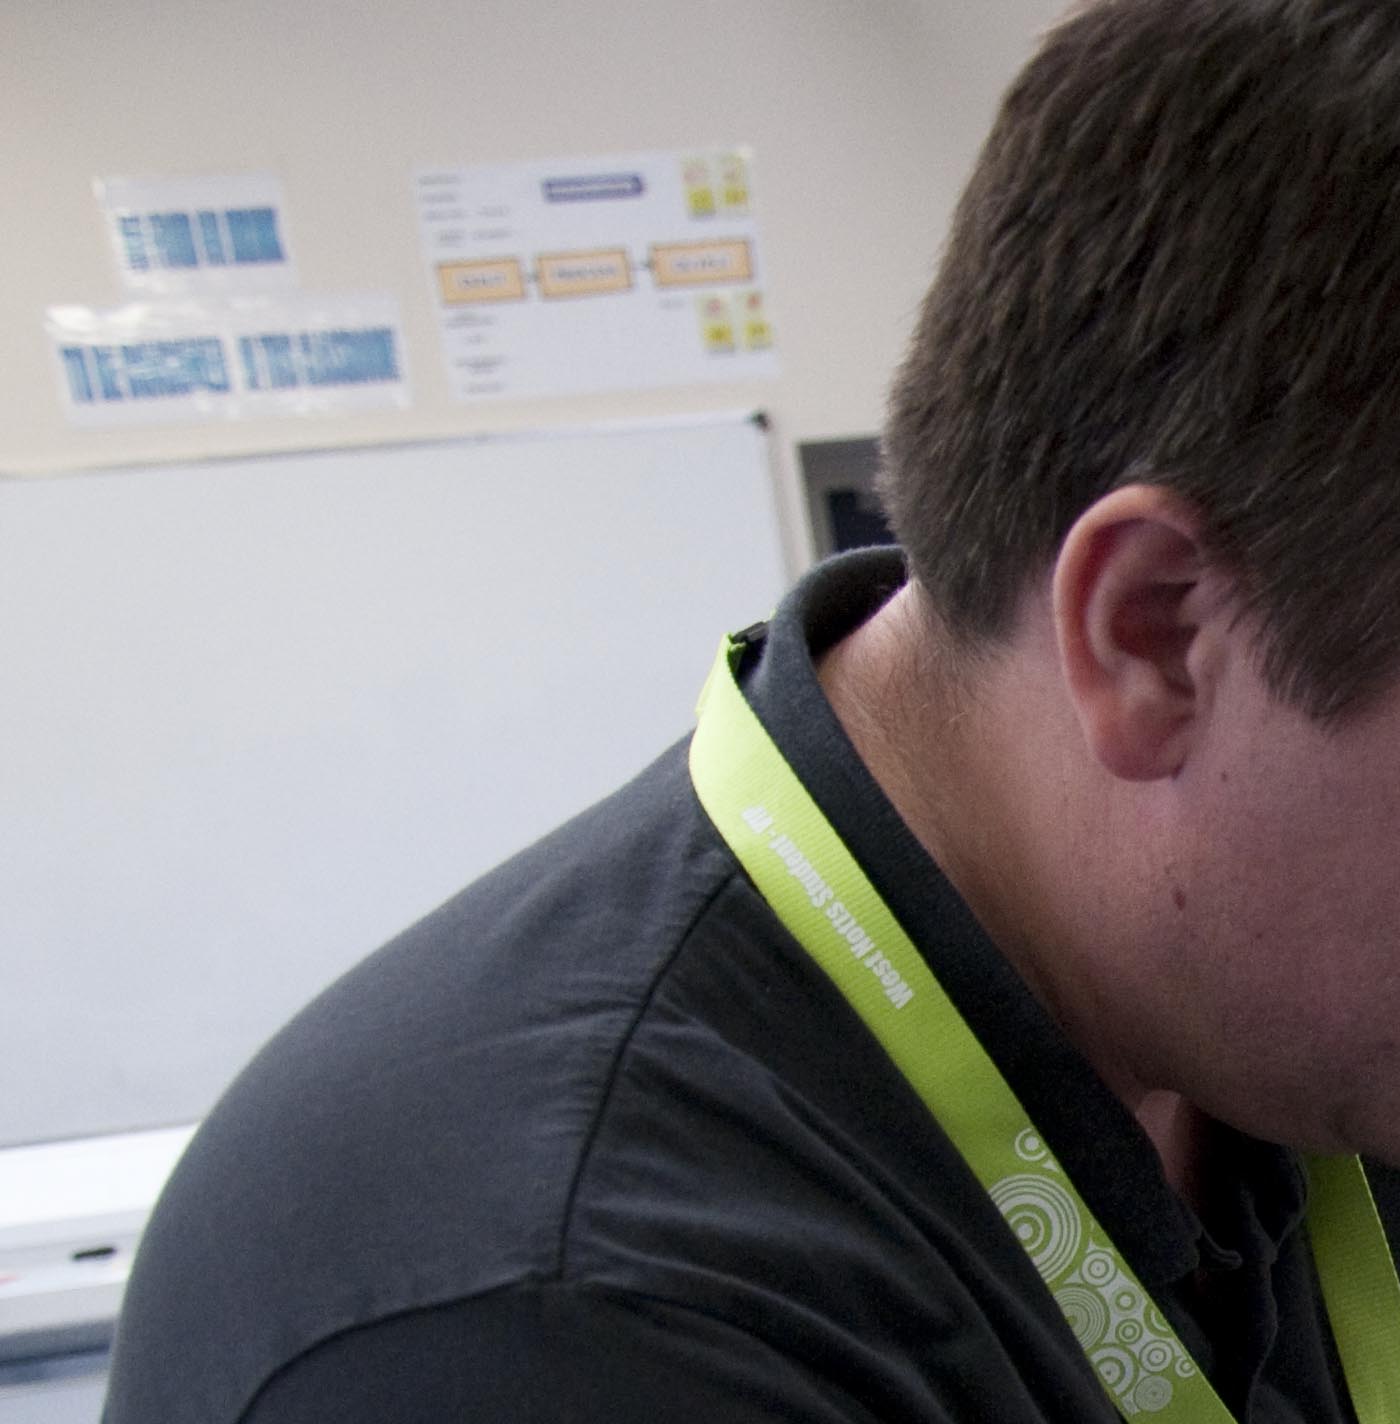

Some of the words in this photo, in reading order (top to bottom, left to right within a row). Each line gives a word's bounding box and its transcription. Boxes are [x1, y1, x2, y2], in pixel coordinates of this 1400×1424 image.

[768, 834, 834, 908] Student
[826, 901, 875, 960] Notts
[864, 950, 915, 1009] West
